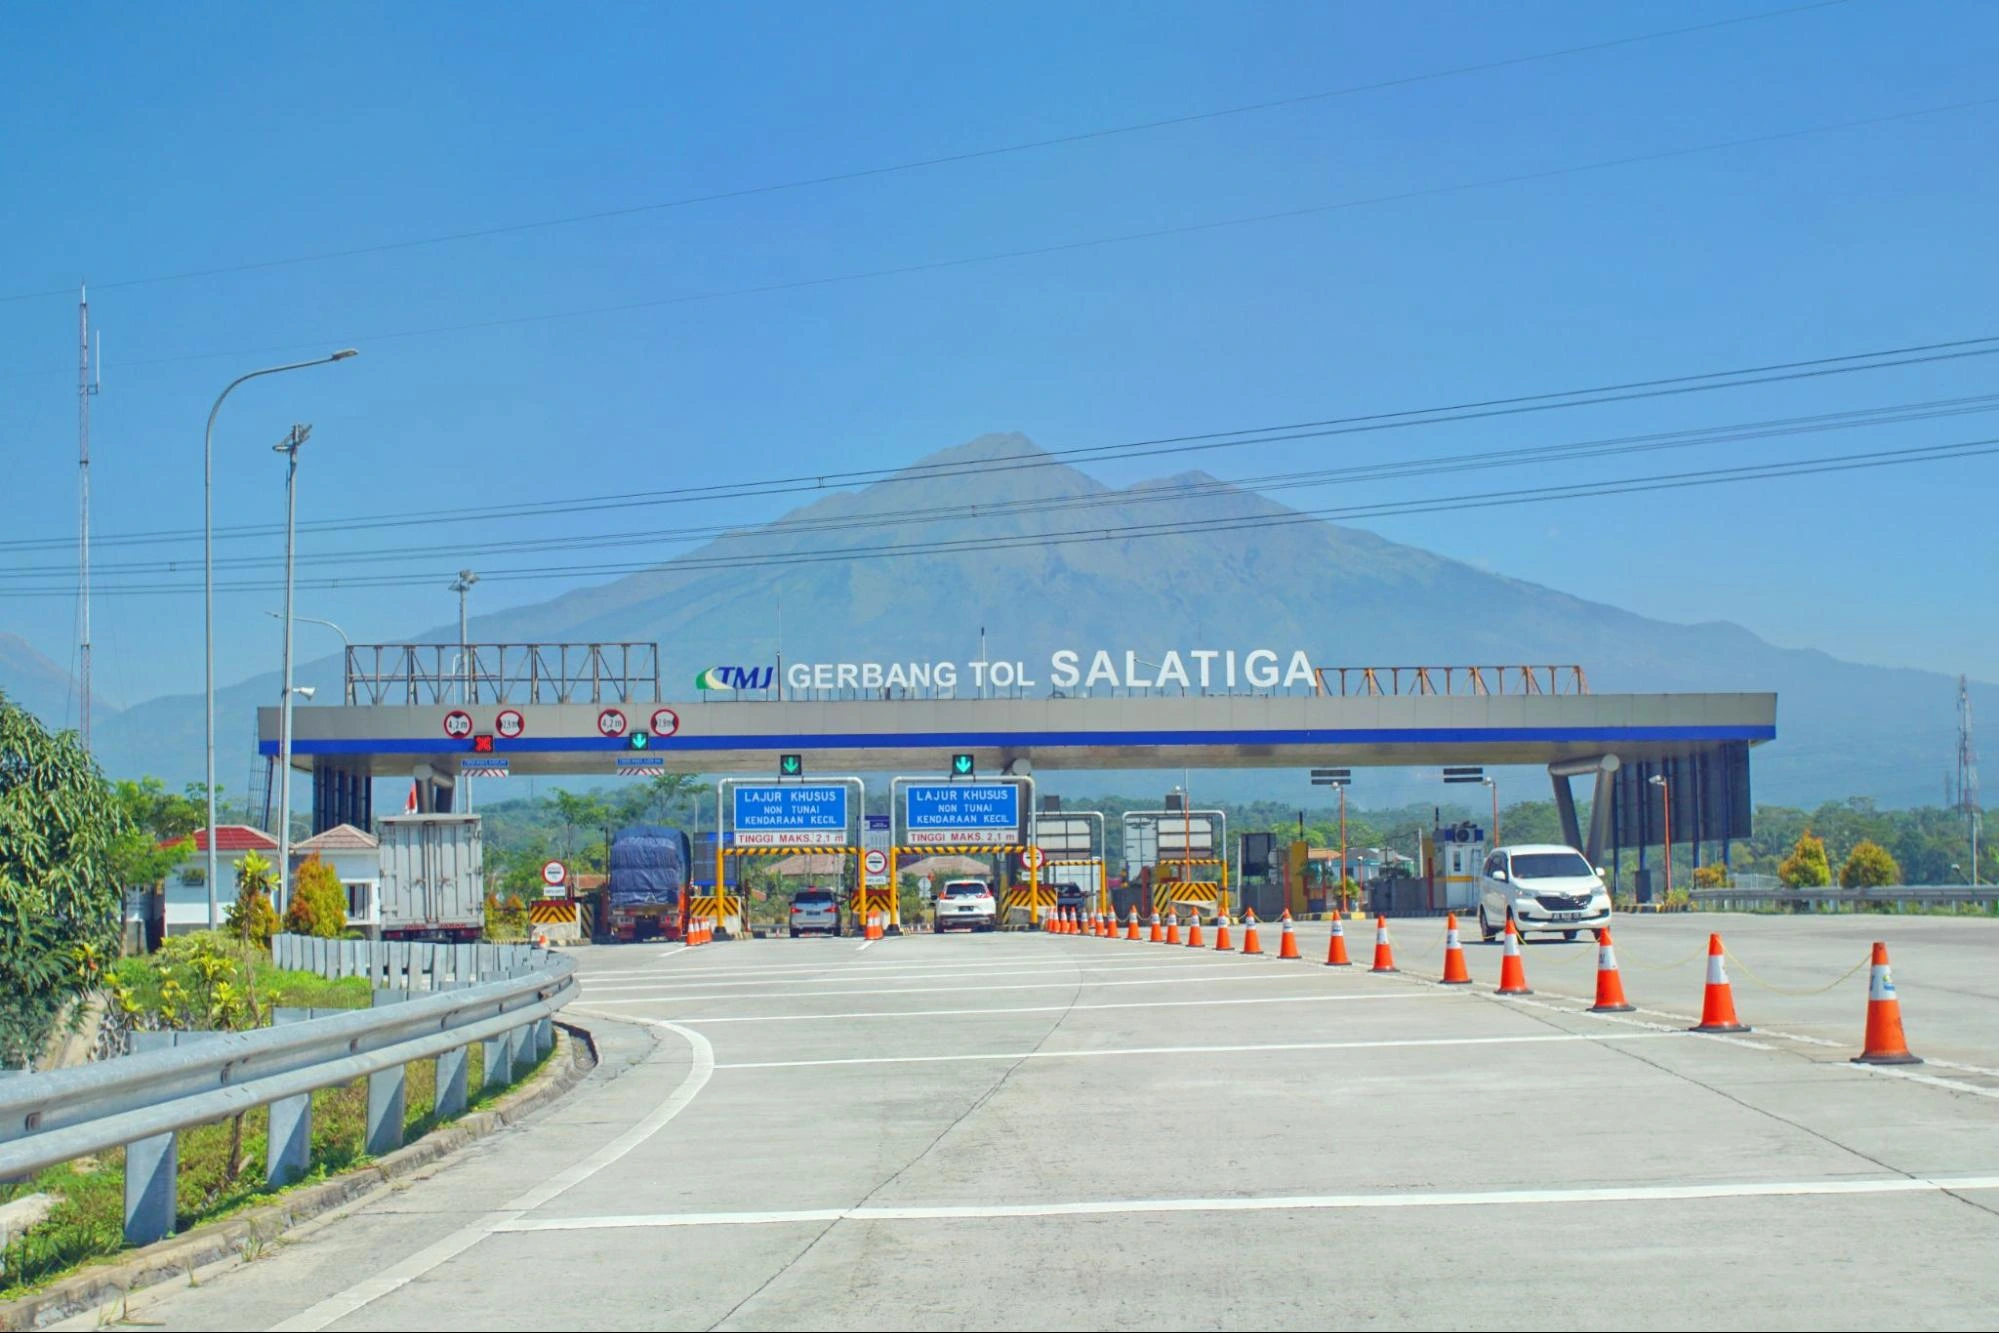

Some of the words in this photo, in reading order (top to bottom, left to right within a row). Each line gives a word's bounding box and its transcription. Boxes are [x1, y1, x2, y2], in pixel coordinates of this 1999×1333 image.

[787, 662, 958, 689] GERBANG
[969, 661, 1035, 687] TOL
[1051, 650, 1319, 689] SALATIGA
[717, 666, 773, 689] TMJ
[744, 792, 782, 802] LAJUR
[790, 791, 837, 802] KHUSUS
[916, 790, 957, 801] LAJUR
[963, 790, 1008, 800] KHUSUS
[763, 805, 782, 814] NON
[791, 805, 820, 814] TUNAI
[938, 804, 957, 813] NON
[964, 803, 992, 812] TUNAI
[745, 816, 804, 825] KENDARAAN
[811, 815, 837, 824] KECIL
[917, 815, 977, 824] KENDARAAN
[984, 814, 1010, 823] KECIL
[738, 834, 774, 843] TINGGI
[911, 833, 945, 842] TINGGI
